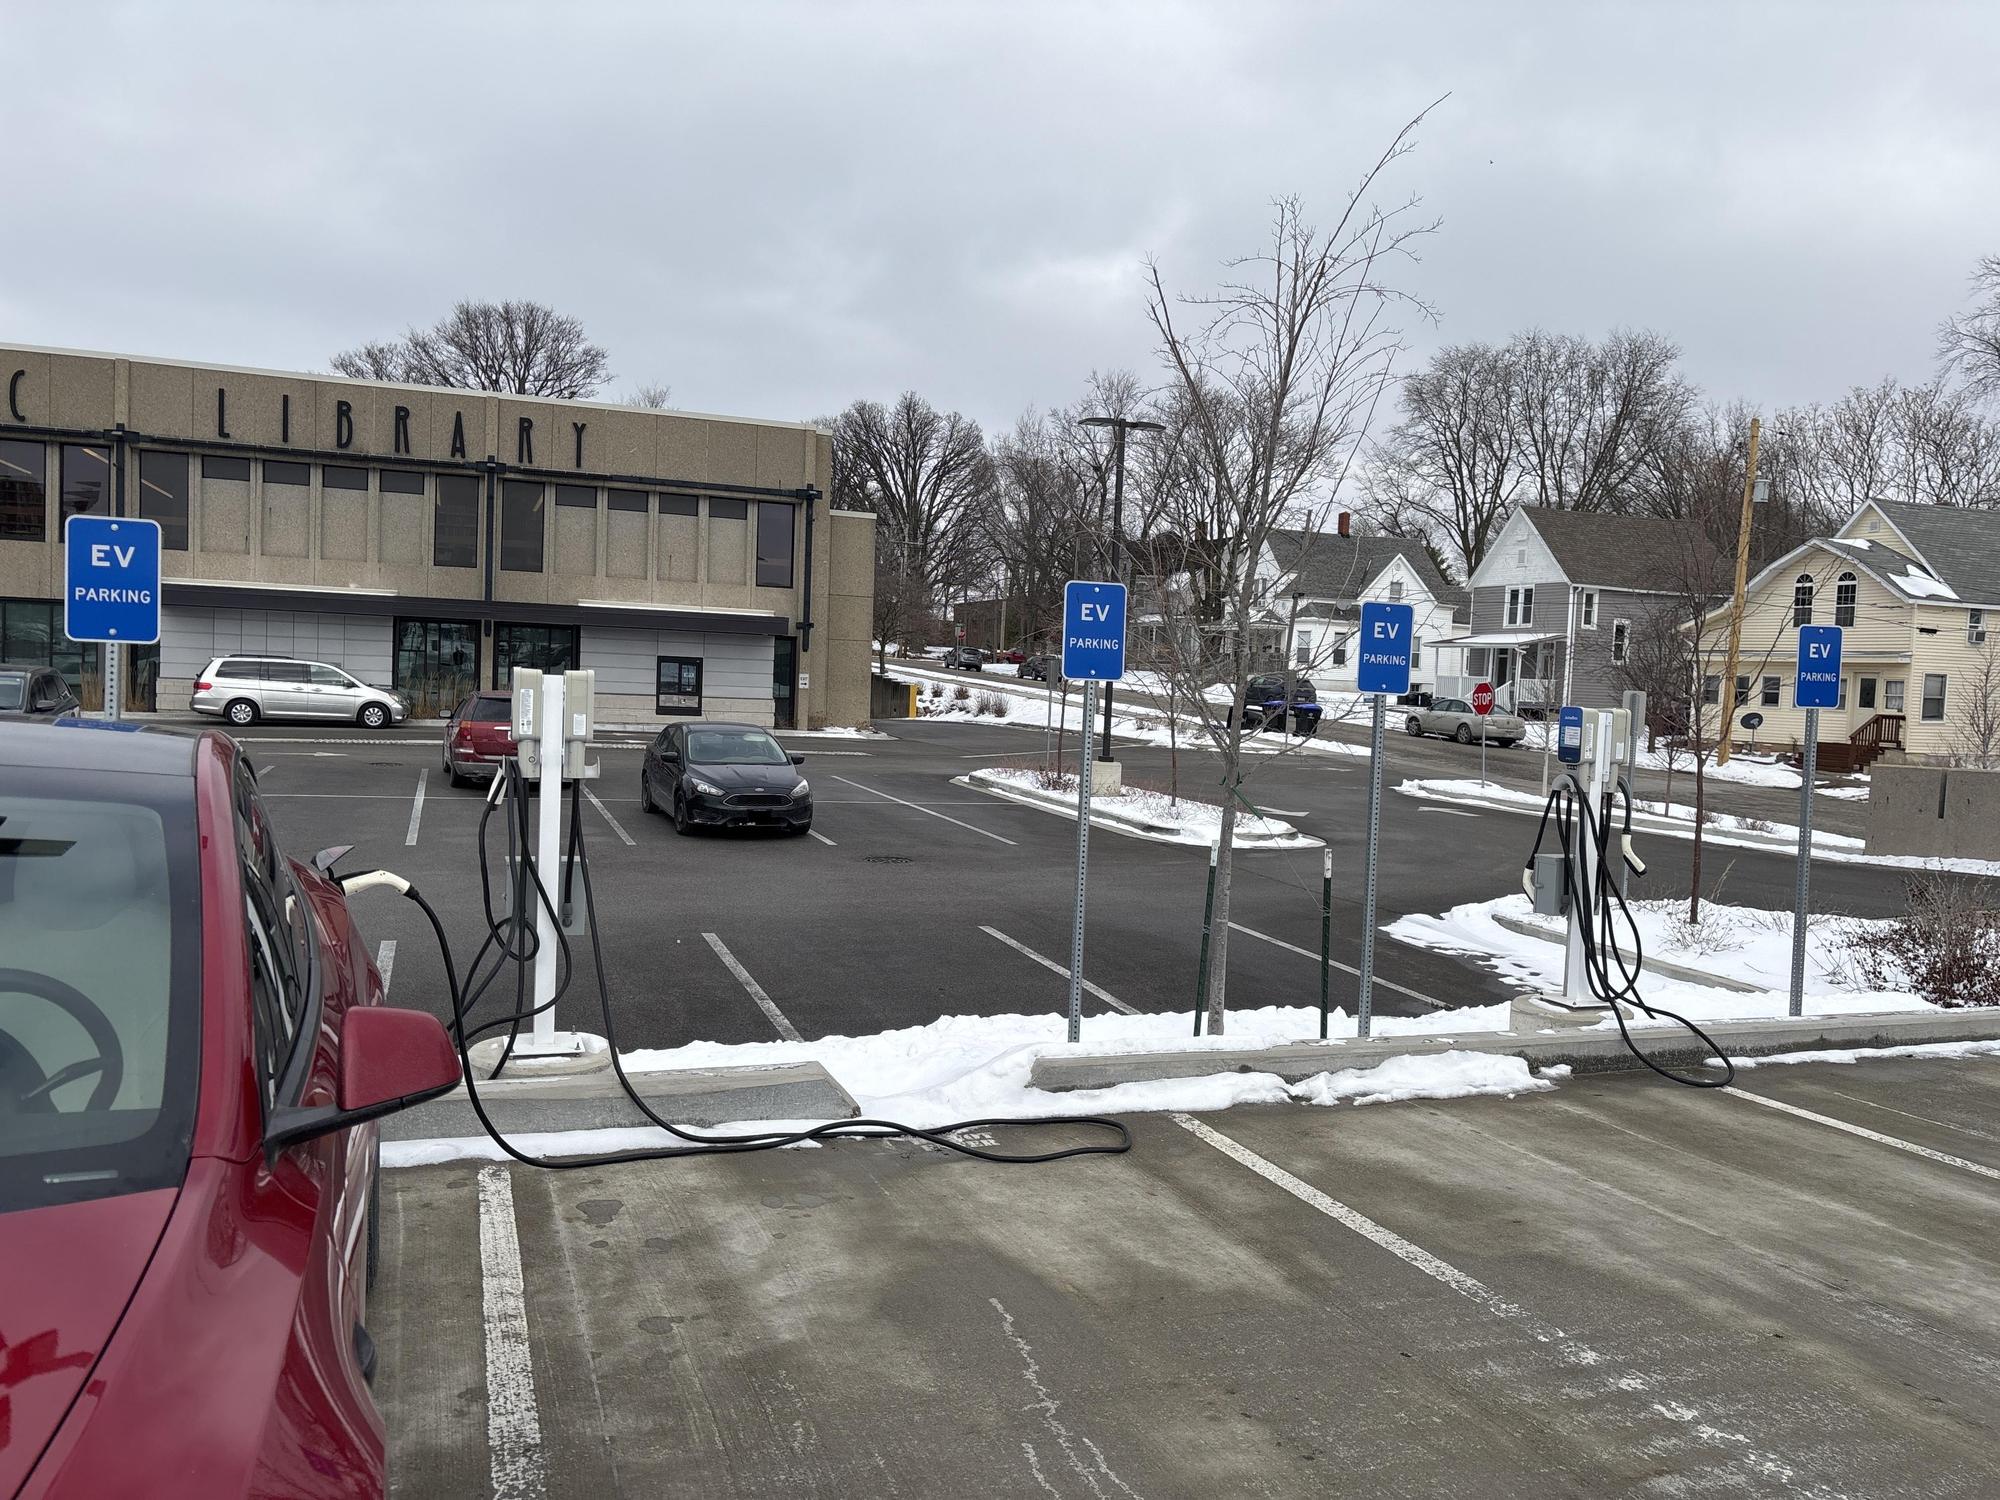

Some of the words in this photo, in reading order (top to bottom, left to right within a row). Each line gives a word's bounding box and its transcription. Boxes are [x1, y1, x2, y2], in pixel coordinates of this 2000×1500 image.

[9, 369, 26, 422] C
[218, 387, 587, 468] LIBRARY
[91, 544, 136, 568] EV
[75, 587, 151, 604] PARKING
[1081, 603, 1110, 621] EV
[1374, 621, 1399, 639] EV
[1069, 637, 1119, 650] PARKING
[1809, 643, 1831, 658] EV
[1363, 653, 1406, 666] PARKING
[1800, 671, 1837, 682] PARKING
[1473, 692, 1492, 706] STOP
